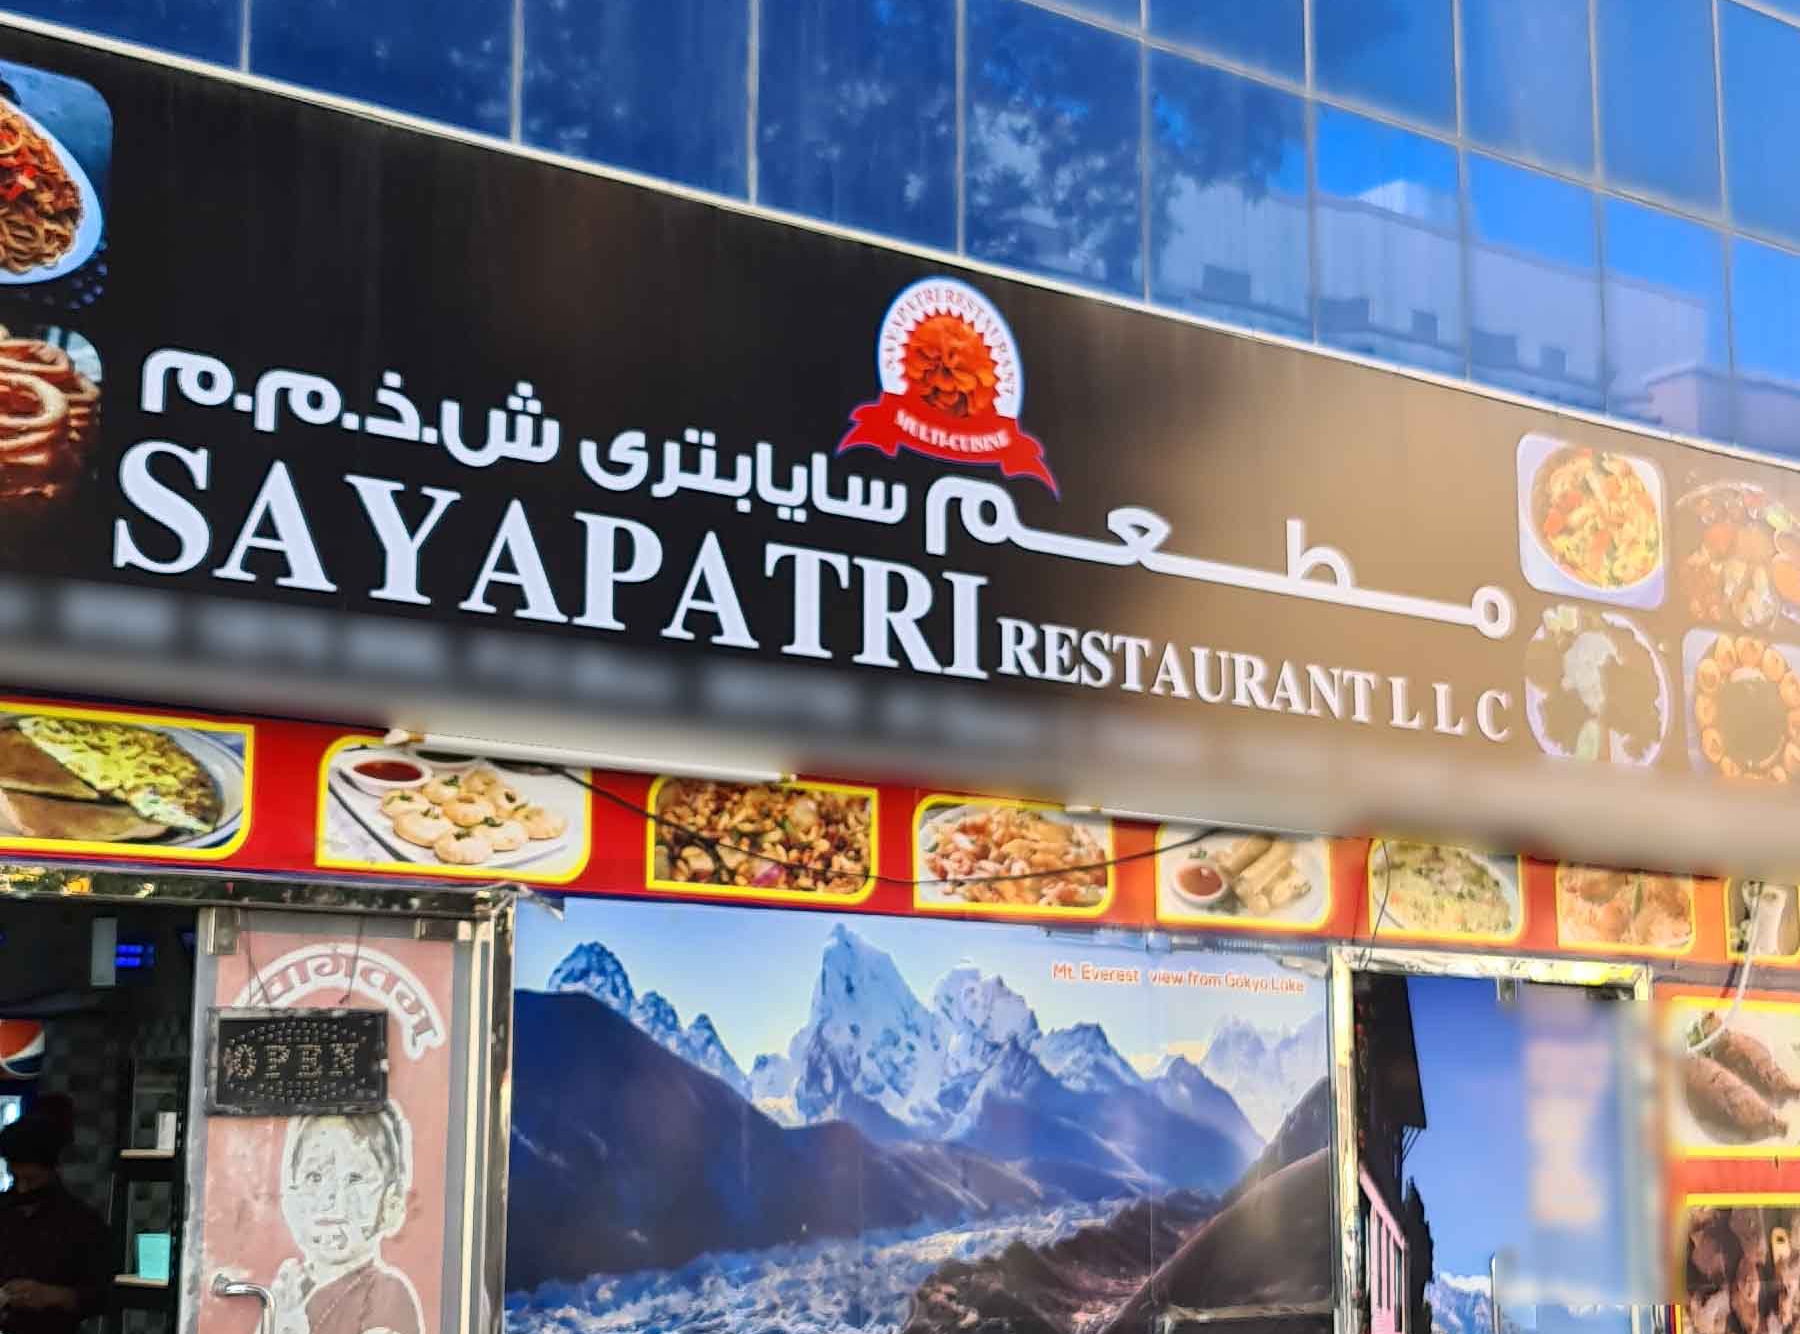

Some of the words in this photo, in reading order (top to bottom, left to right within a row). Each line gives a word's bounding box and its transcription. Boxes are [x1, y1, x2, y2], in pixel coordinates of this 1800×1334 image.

[113, 440, 989, 681] SAYAPATRI
[997, 617, 1377, 725] RESTAURANT
[1052, 963, 1076, 981] Mt.
[1081, 964, 1140, 984] Everest
[1149, 969, 1185, 986] view
[1187, 970, 1222, 988] from
[1225, 971, 1270, 993] Gokyo
[1271, 975, 1305, 994] Lake
[224, 1042, 360, 1078] OPEN
